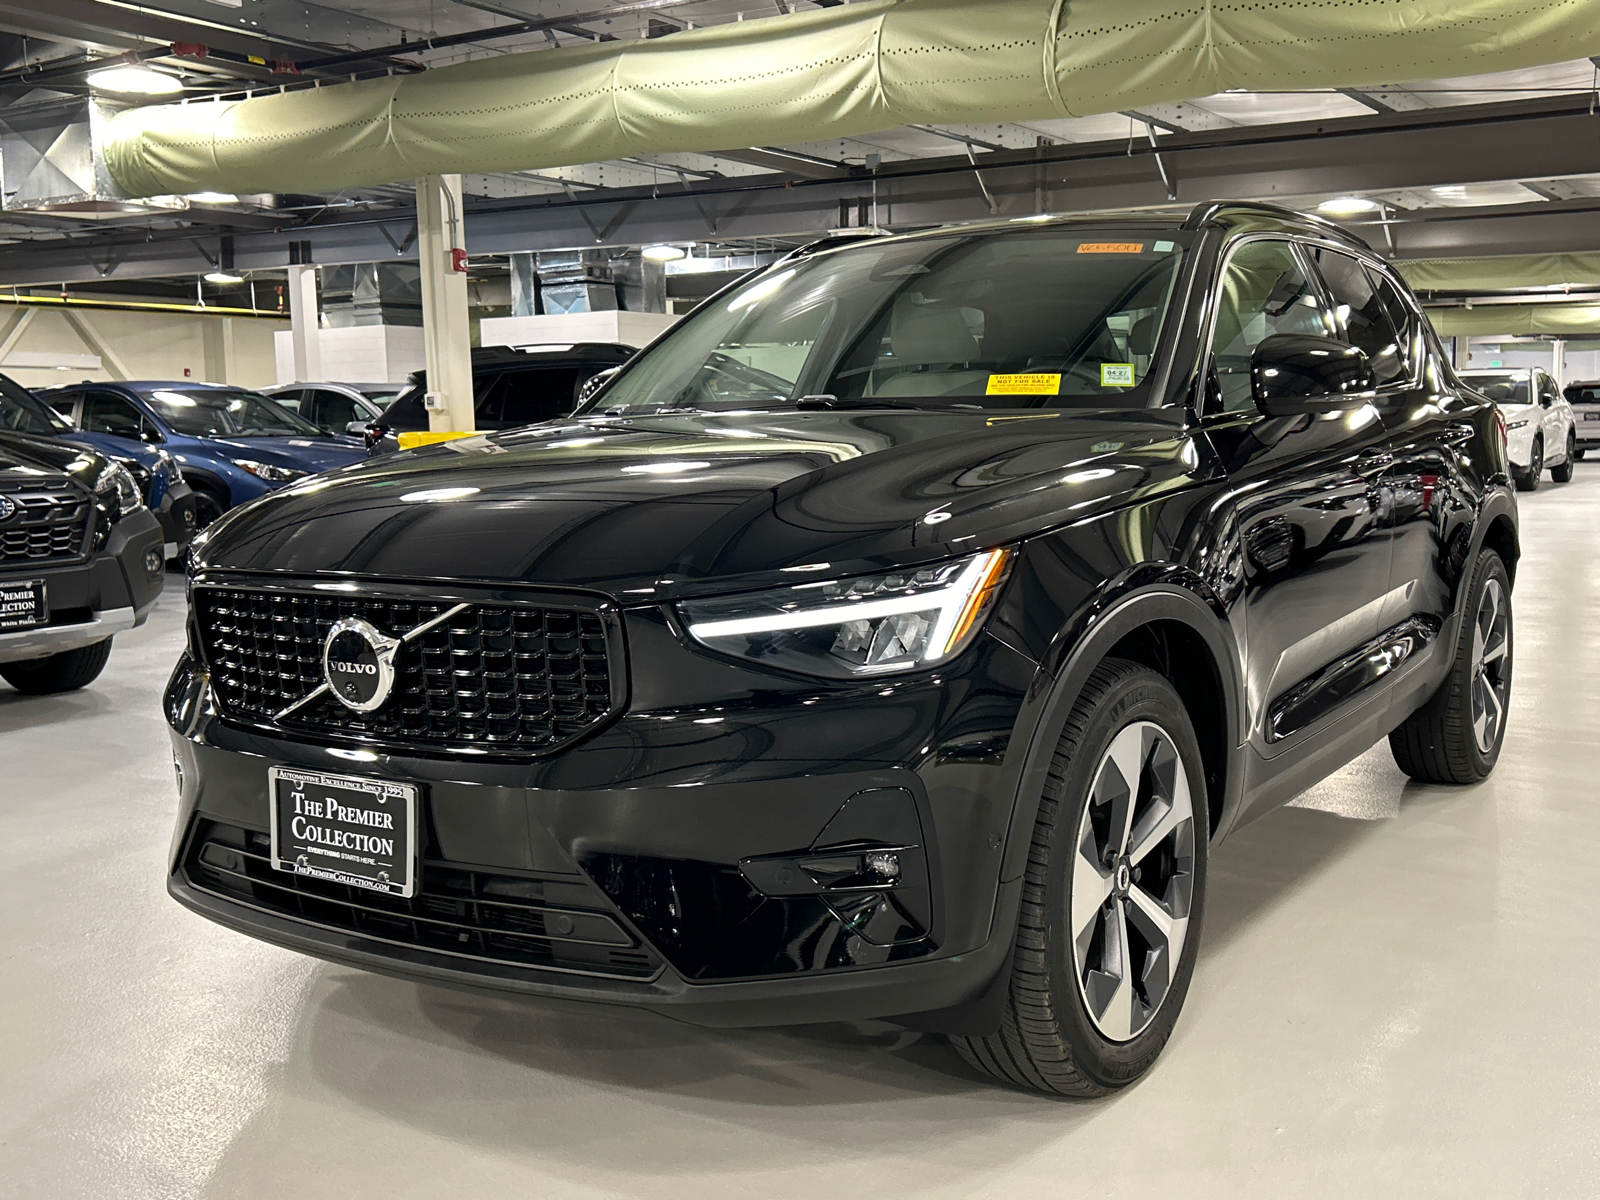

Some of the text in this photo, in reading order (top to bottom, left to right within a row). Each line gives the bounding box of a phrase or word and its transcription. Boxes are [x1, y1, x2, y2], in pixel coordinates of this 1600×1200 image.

[330, 660, 377, 675] VOLVO
[279, 769, 320, 783] AUTOMOTIVE
[321, 776, 361, 788] EXCELLENCE
[383, 786, 403, 797] 1995
[291, 791, 394, 829] THE PREMIER
[291, 816, 394, 856] COLLECTION
[306, 846, 341, 858] EVERYTHING
[341, 853, 361, 862] STARTS
